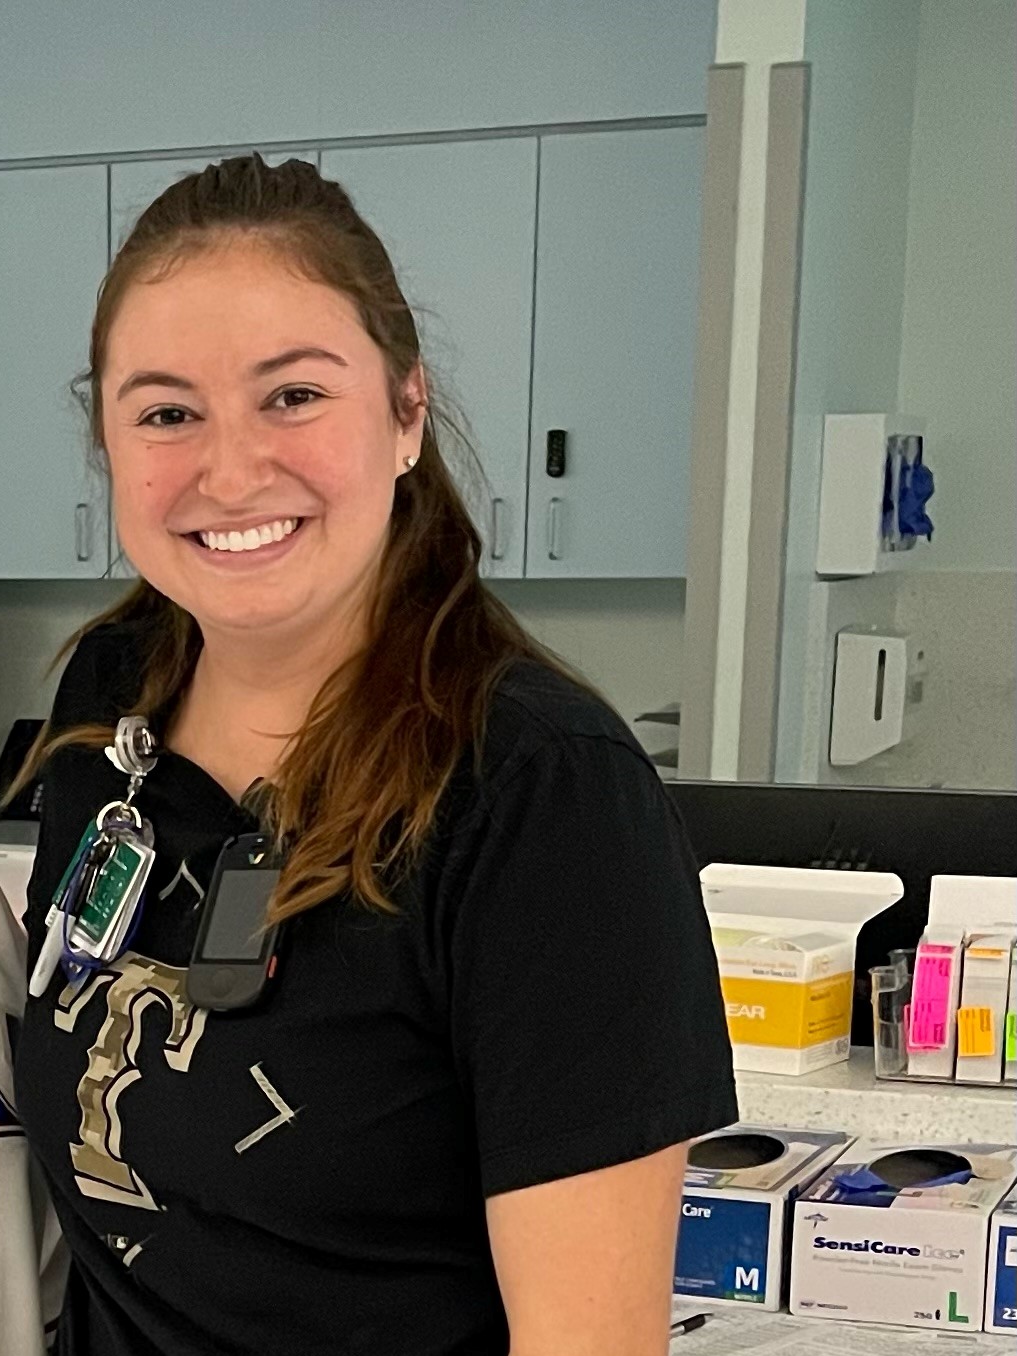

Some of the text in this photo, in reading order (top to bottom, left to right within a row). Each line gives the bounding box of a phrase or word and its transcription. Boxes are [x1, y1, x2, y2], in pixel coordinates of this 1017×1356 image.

[682, 1203, 712, 1219] Care
[813, 1236, 921, 1257] SensiCare
[735, 1266, 760, 1291] M
[948, 1291, 969, 1324] L
